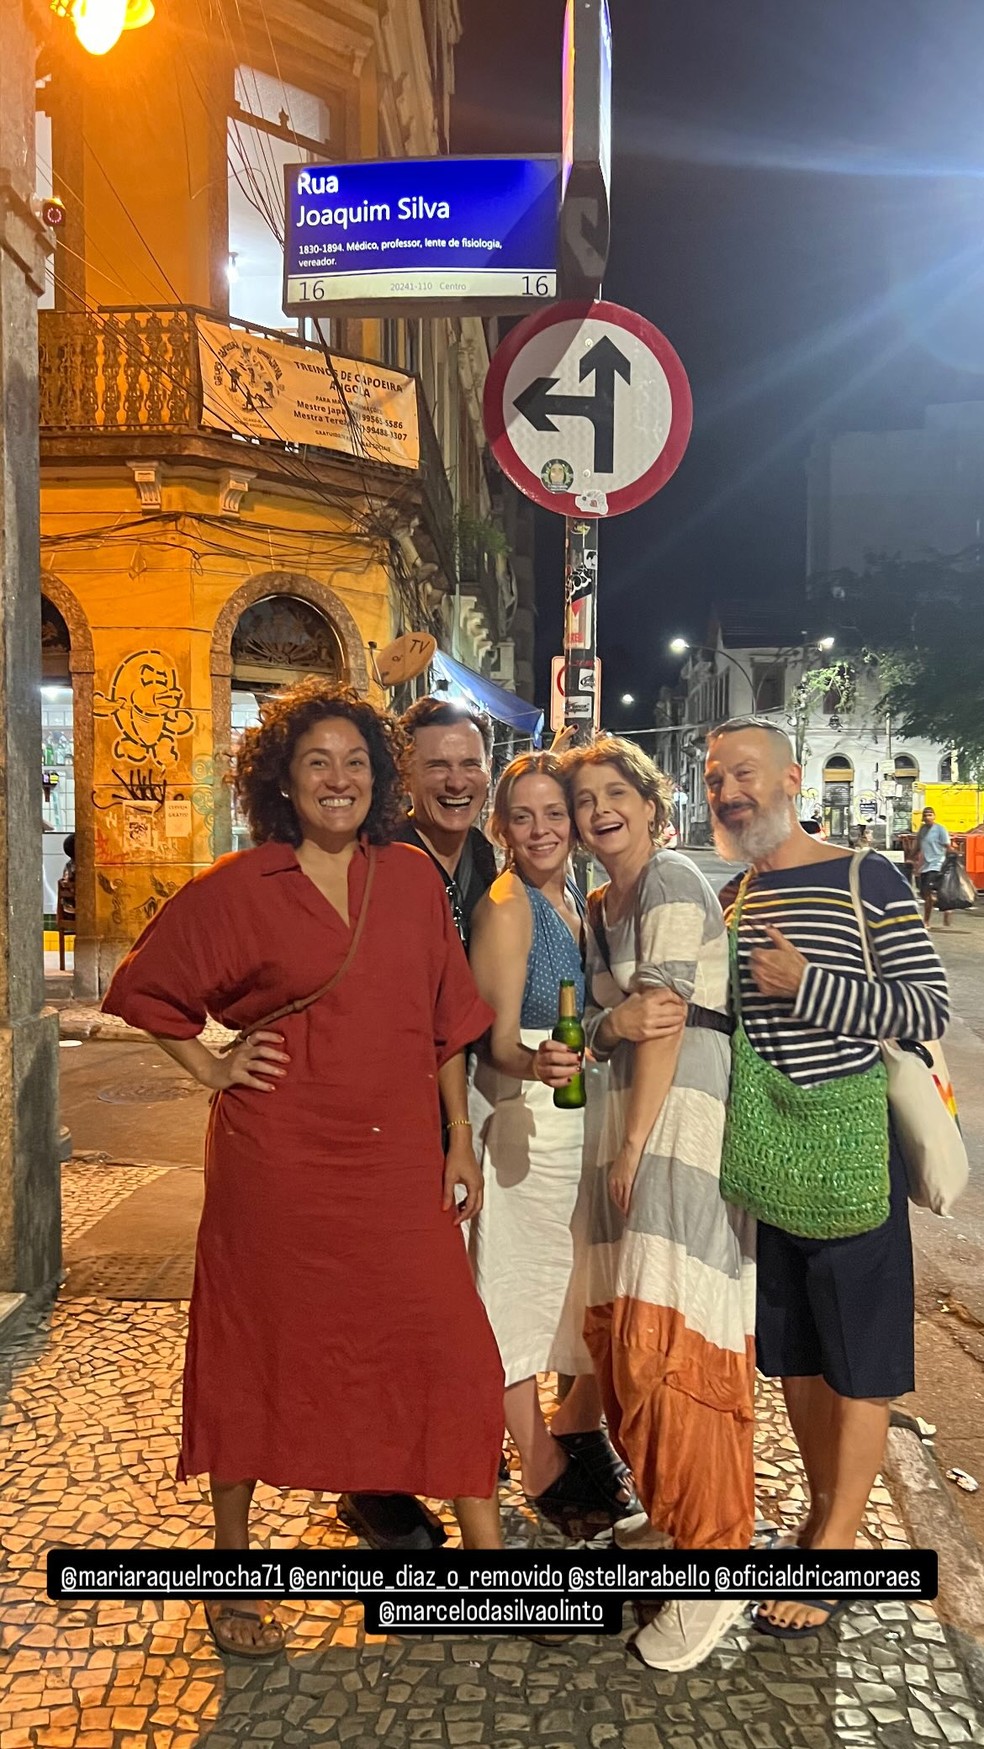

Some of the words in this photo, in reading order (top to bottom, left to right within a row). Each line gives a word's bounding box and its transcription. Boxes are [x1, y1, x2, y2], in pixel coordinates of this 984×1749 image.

[297, 171, 339, 195] Rua
[296, 200, 391, 230] Joaquim
[397, 195, 450, 220] Silva
[298, 243, 345, 255] 1830-1894.
[346, 238, 379, 252] Médico,
[381, 238, 423, 251] professor,
[424, 237, 447, 248] lente
[447, 237, 460, 248] de
[461, 237, 502, 250] fisiologia,
[298, 255, 337, 267] vereador.
[299, 279, 325, 301] 16
[390, 282, 433, 291] 20241-110
[439, 282, 467, 291] Centro
[521, 275, 549, 296] 16
[341, 370, 352, 382] DE
[297, 400, 327, 413] Mestre
[293, 410, 324, 423] Mestra
[409, 639, 431, 654] TV
